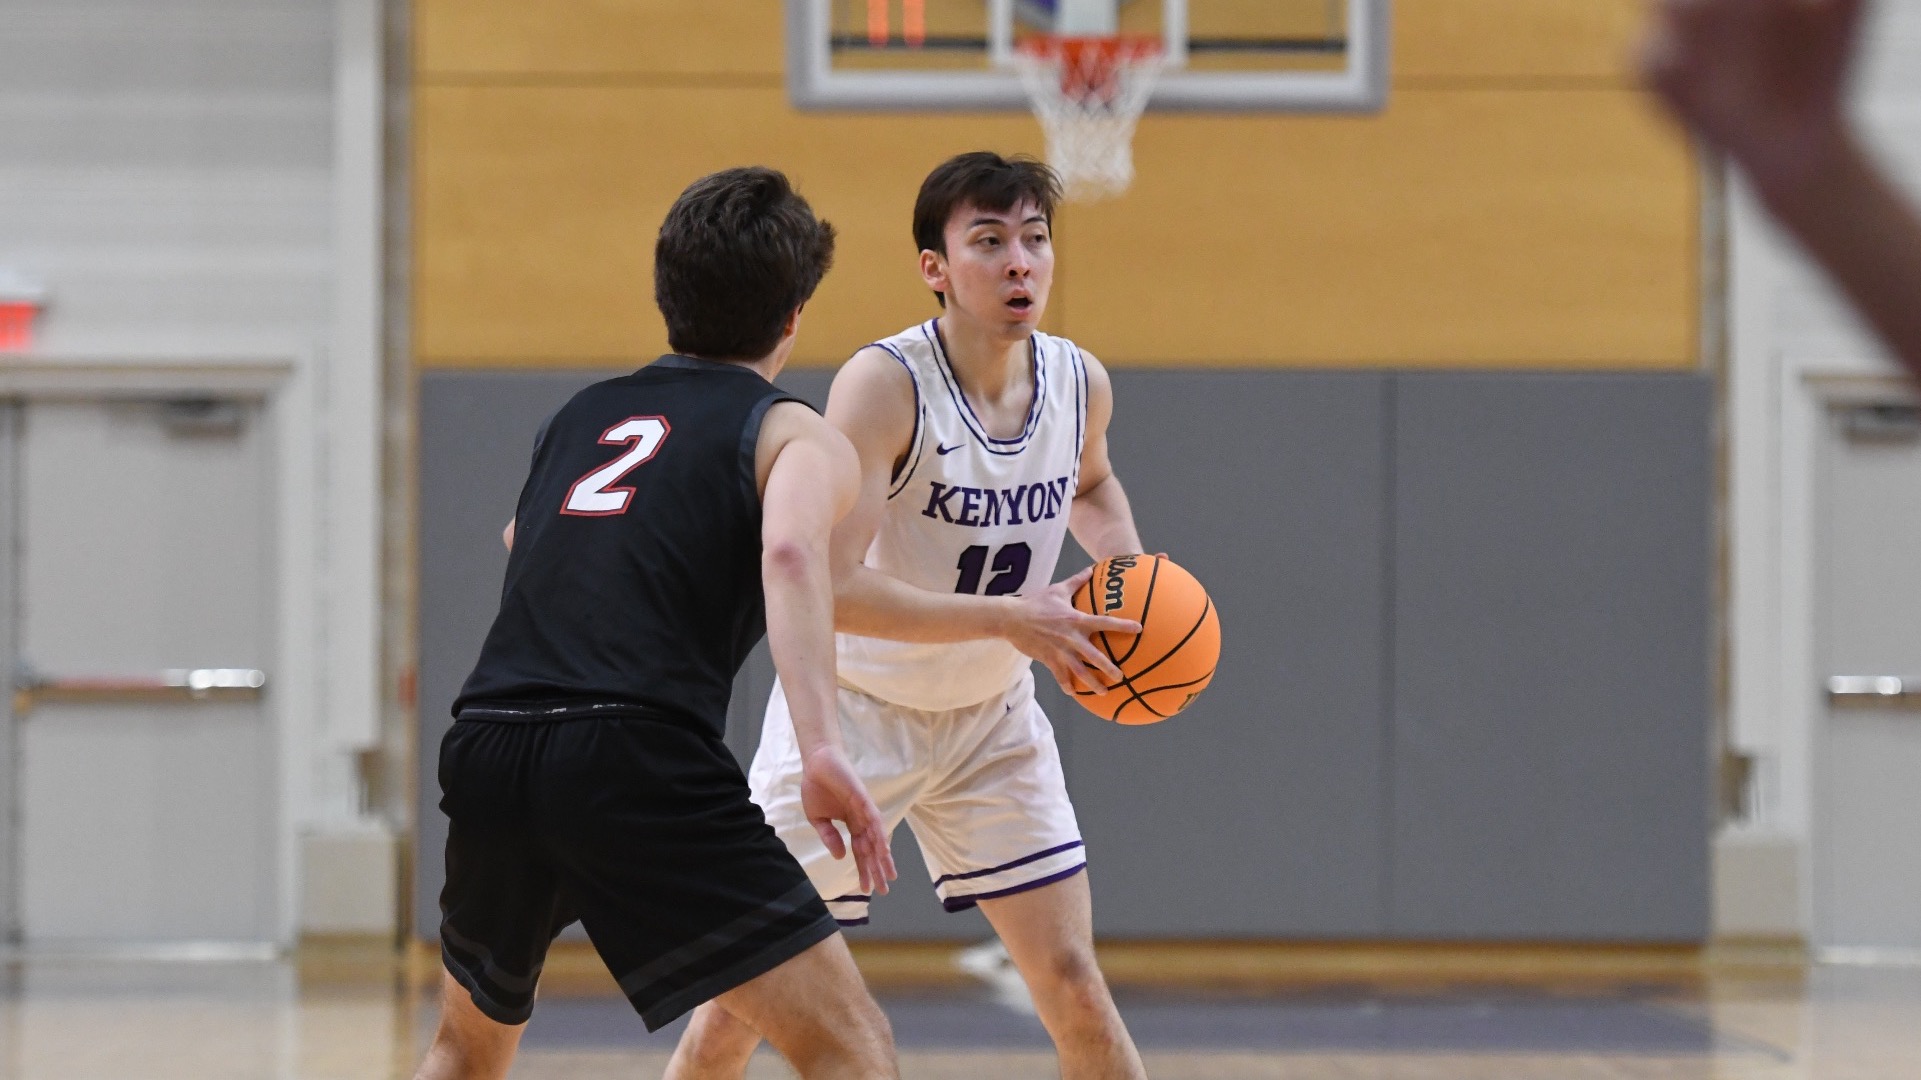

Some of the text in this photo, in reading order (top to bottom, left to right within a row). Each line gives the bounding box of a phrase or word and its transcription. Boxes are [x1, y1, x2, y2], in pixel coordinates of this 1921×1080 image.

[559, 414, 672, 517] 2
[921, 476, 1069, 528] KENYON
[954, 541, 1033, 597] 12
[1105, 554, 1138, 613] ilson
